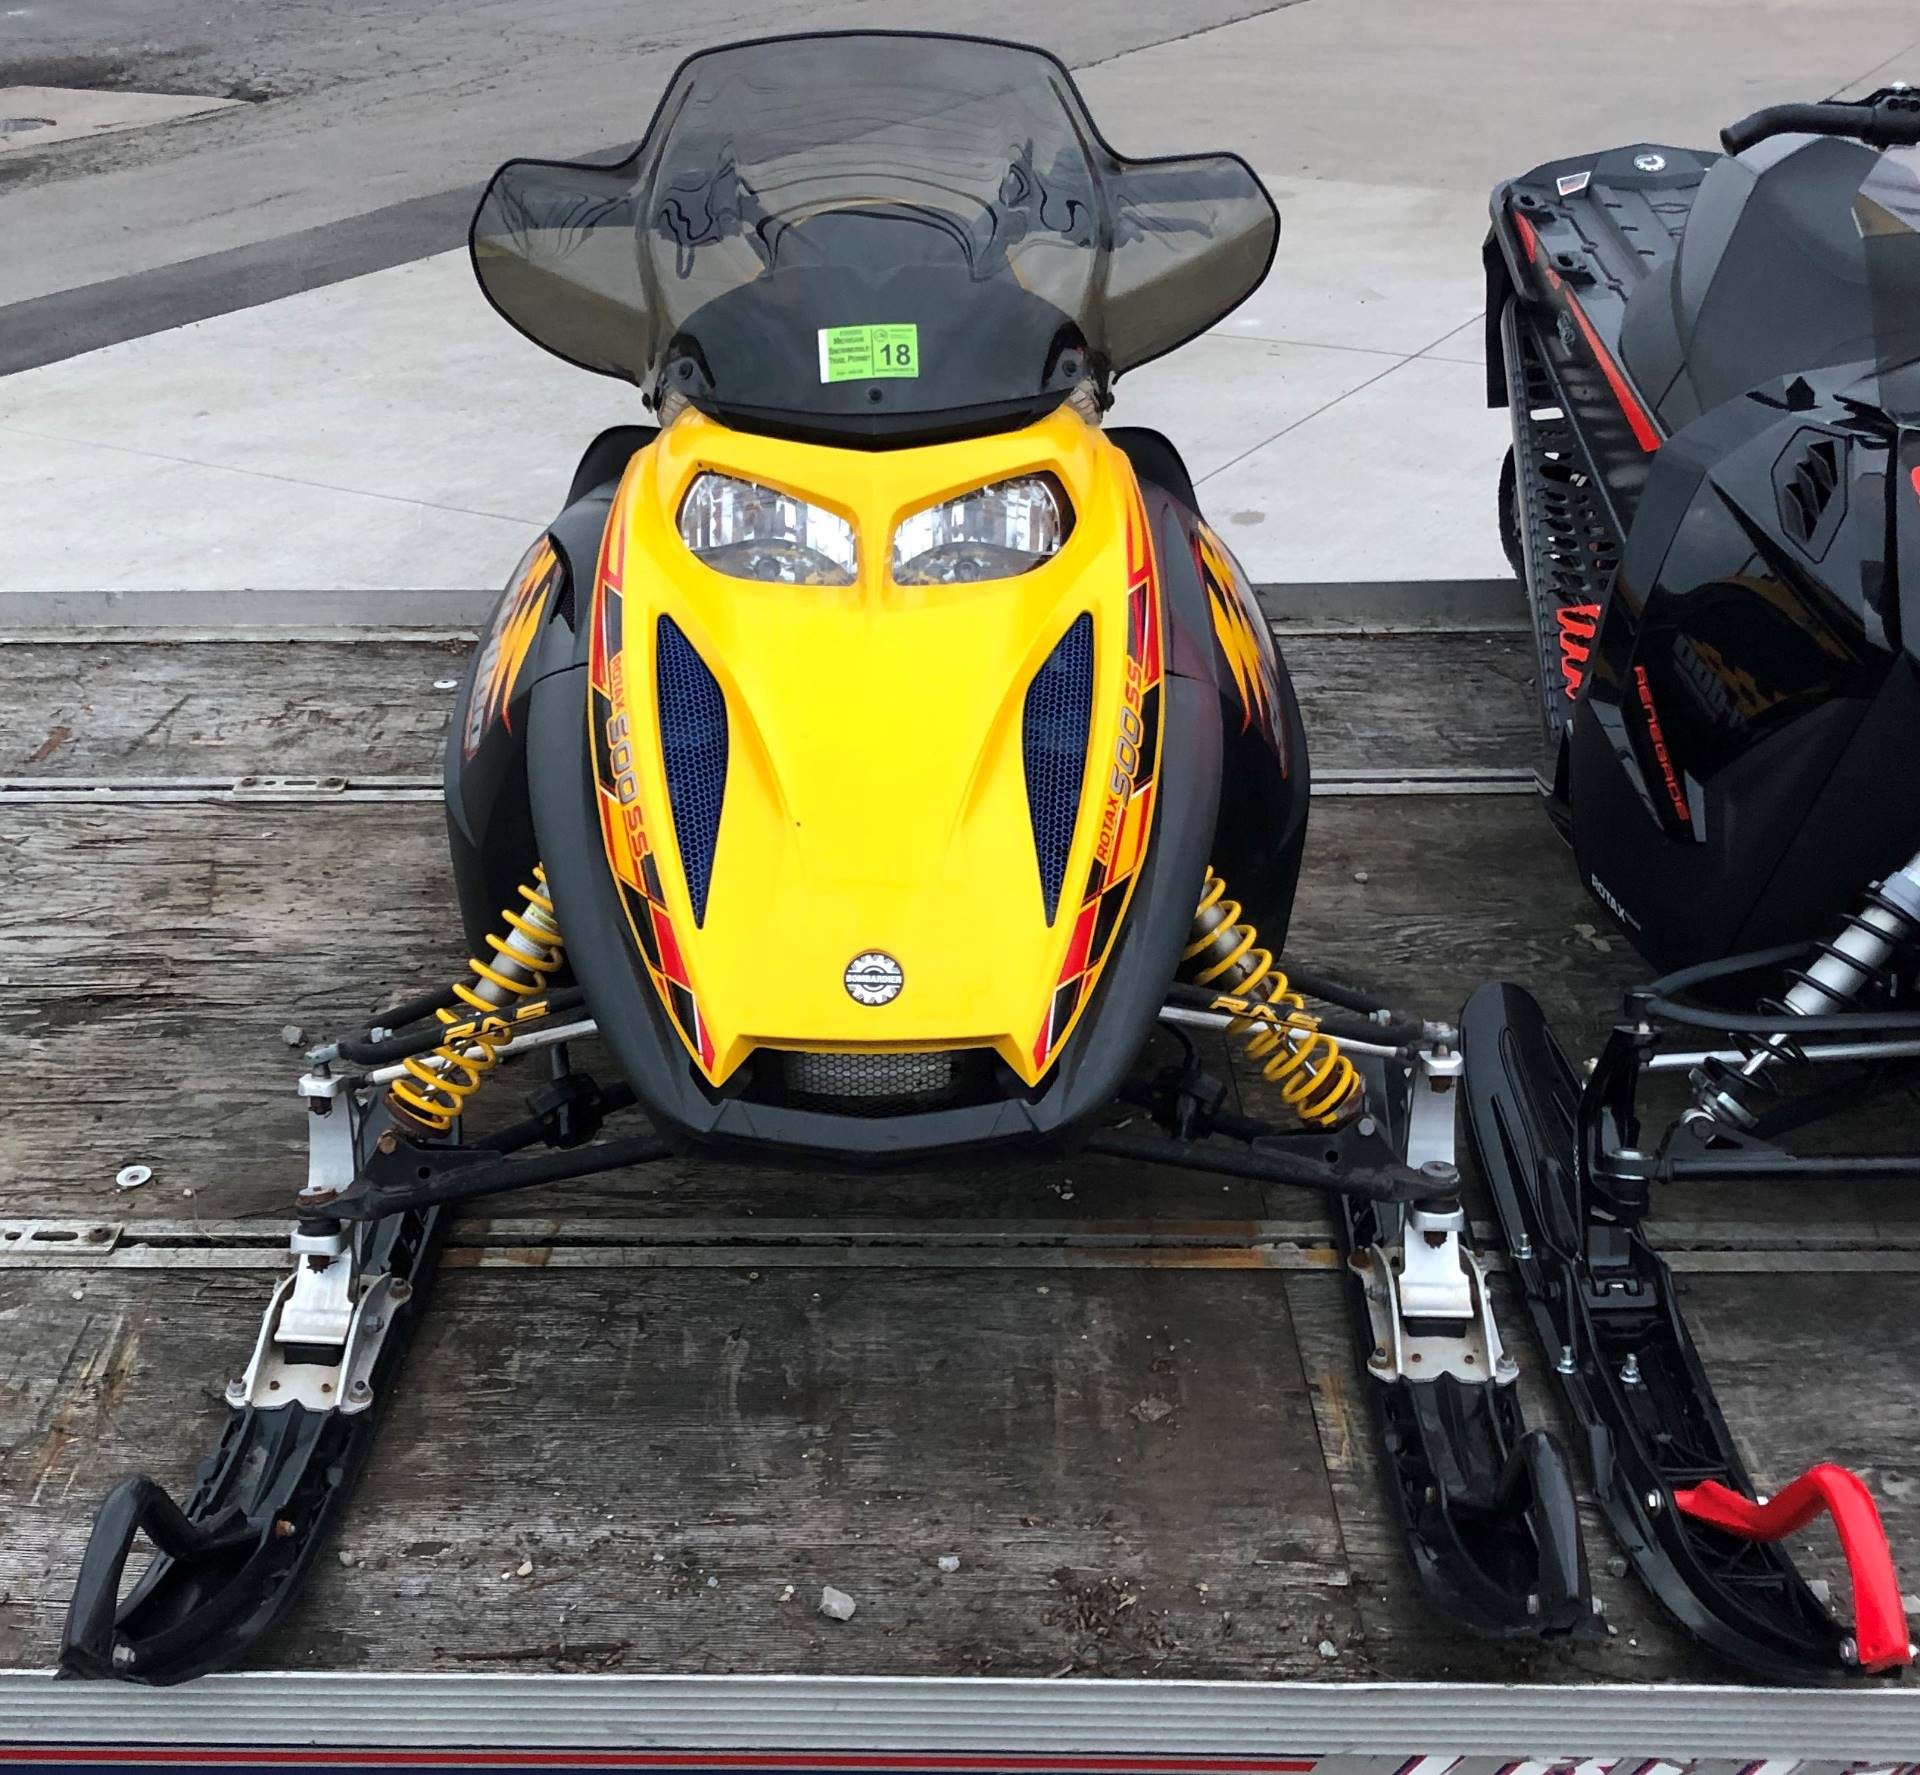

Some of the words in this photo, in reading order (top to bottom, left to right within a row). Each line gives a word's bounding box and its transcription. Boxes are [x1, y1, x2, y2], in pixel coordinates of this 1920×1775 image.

[880, 343, 911, 366] 18
[610, 656, 625, 713] ROTAX
[1124, 659, 1143, 713] SS
[608, 713, 638, 803] 500
[1110, 706, 1141, 807] 500
[623, 805, 649, 859] SS
[1096, 796, 1119, 863] ROTAX
[1590, 872, 1626, 923] ROTAX
[845, 974, 902, 984] BOMBARDIER
